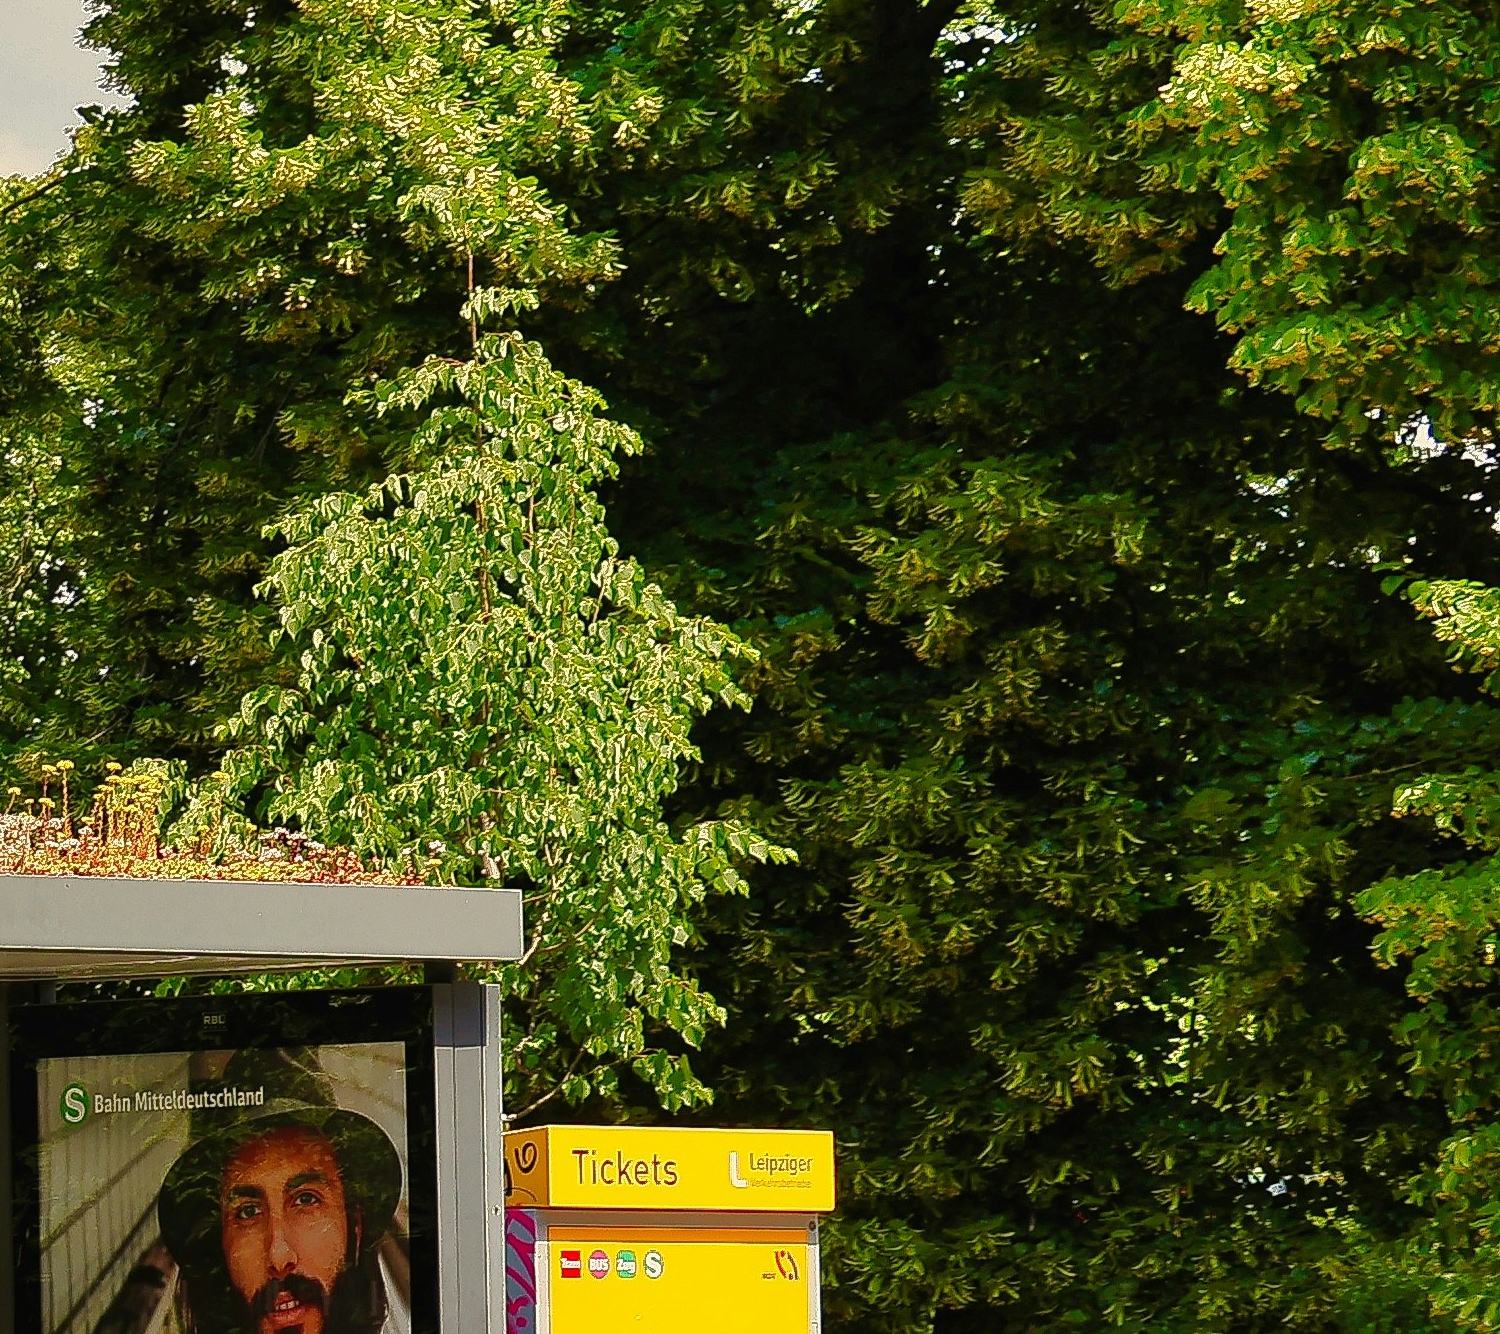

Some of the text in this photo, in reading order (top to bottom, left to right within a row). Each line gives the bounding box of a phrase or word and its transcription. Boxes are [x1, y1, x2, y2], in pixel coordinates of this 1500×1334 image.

[203, 1015, 226, 1025] RBL
[64, 1085, 264, 1122] S Bahn Mitteldeutschland
[572, 1149, 678, 1186] Tickets
[750, 1152, 813, 1175] Leipziger
[590, 1258, 609, 1271] BUS
[615, 1258, 636, 1273] Zug
[644, 1251, 665, 1278] S
